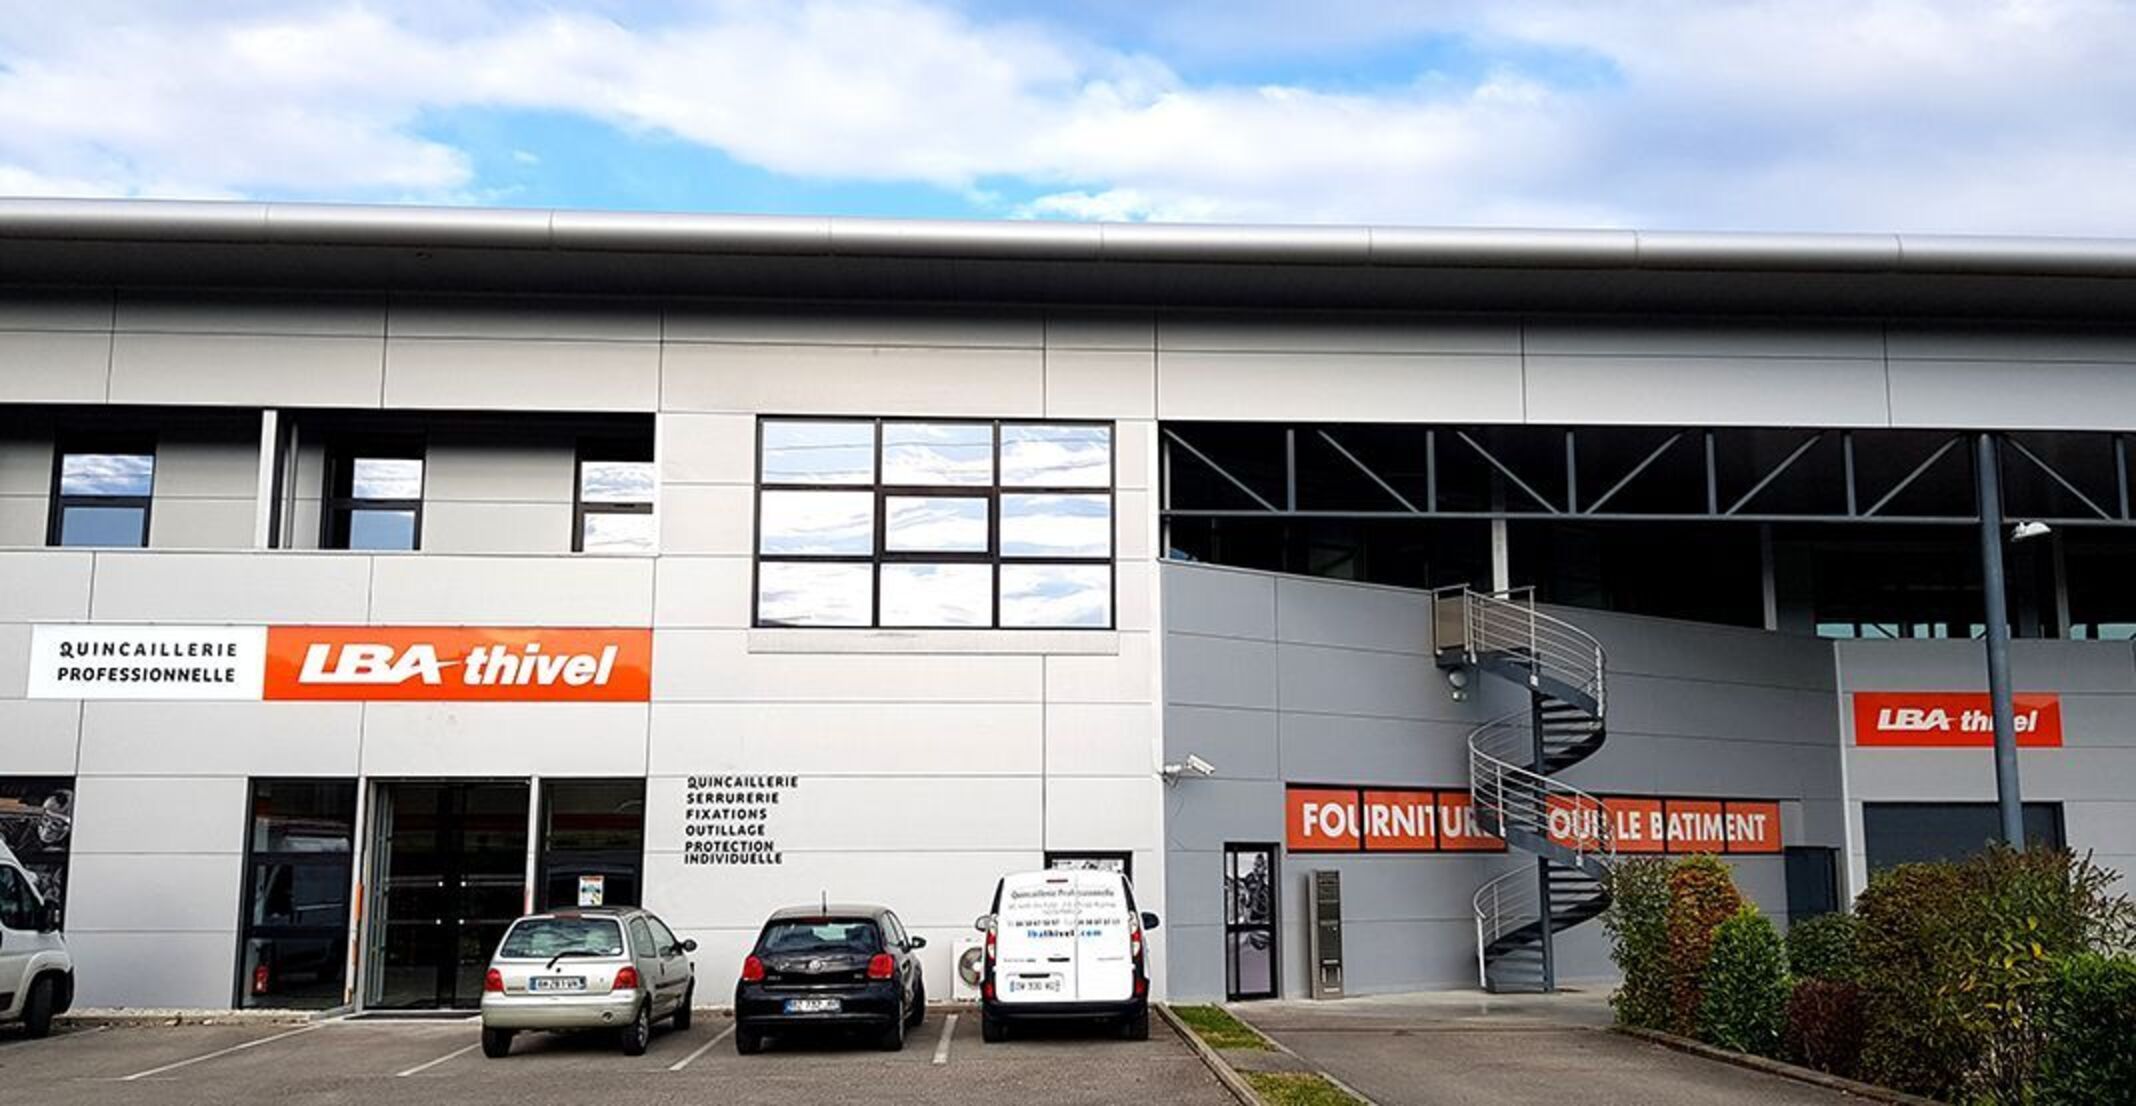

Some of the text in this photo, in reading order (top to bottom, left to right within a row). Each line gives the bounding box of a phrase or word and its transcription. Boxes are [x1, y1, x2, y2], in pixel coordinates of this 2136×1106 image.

[59, 641, 237, 658] QUINCAILLERIE
[298, 643, 618, 685] LBA thivel
[57, 667, 235, 682] PROFESSIONNELLE
[1876, 708, 2038, 732] LBA thel
[687, 776, 799, 790] QUINCAILLERIE
[686, 792, 780, 804] SERRURERIE
[685, 808, 767, 820] FIXATIONS
[1303, 802, 1495, 838] FOURNITUR
[1616, 811, 1641, 840] LE
[1651, 811, 1766, 842] BATIMENT
[685, 824, 765, 836] OUTILLAGE
[685, 841, 775, 852] PROTECTION
[684, 853, 782, 864] INDIVIDUELLE
